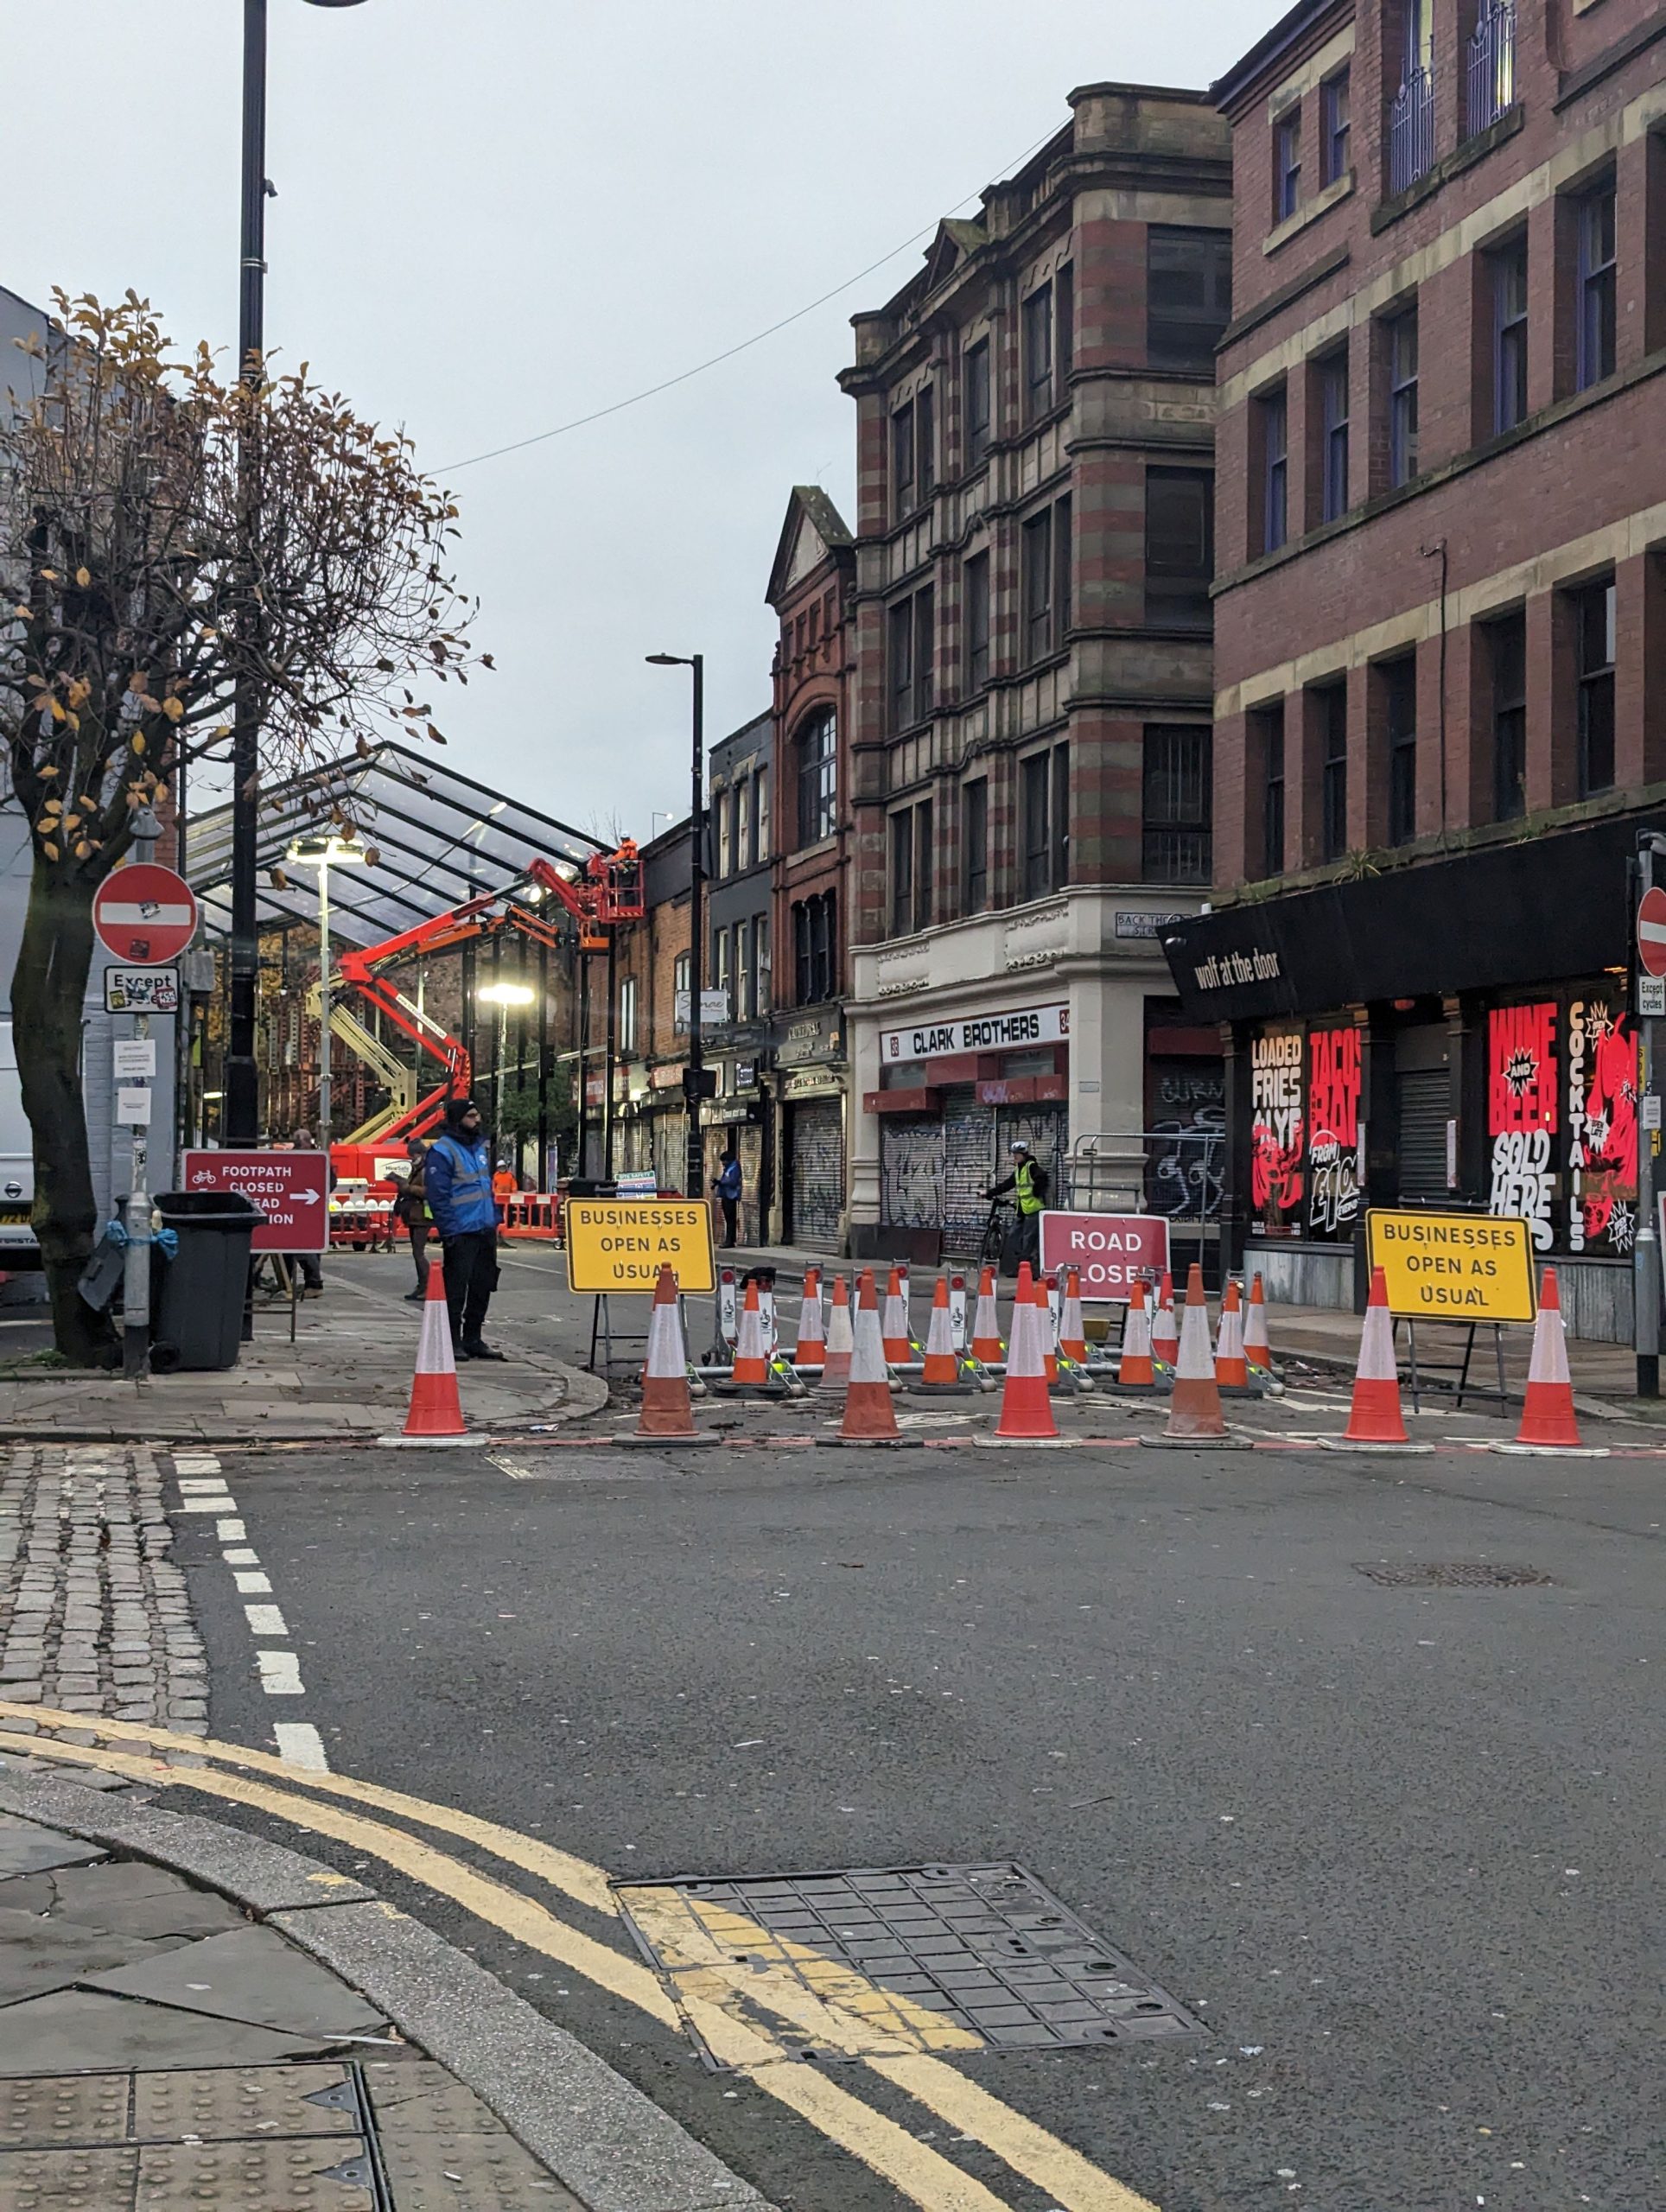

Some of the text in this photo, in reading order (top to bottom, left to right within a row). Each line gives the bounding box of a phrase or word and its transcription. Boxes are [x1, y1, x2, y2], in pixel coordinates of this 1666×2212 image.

[1118, 915, 1145, 925] BACK
[1194, 947, 1280, 989] wolf at the door
[114, 974, 172, 989] Except
[1642, 982, 1663, 994] Except
[1643, 1000, 1663, 1010] cycles
[913, 1014, 1040, 1055] CLARK BROTHERS
[1489, 1002, 1557, 1074] WINE
[1251, 1035, 1301, 1069] LOADED
[1510, 1063, 1530, 1078] AND
[1252, 1066, 1301, 1109] FRIES
[1489, 1071, 1557, 1136] BEER
[1568, 1001, 1585, 1251] COCKTAILS
[1311, 1141, 1338, 1165] FROM
[1491, 1128, 1550, 1175] SOLD
[222, 1166, 291, 1177] FOOTPATH
[230, 1182, 283, 1192] CLOSED
[1489, 1173, 1555, 1218] HERE
[581, 1210, 697, 1225] BUSINESSES
[601, 1237, 681, 1251] OPEN AS
[1071, 1230, 1141, 1251] ROAD
[1383, 1224, 1516, 1247] BUSINESSES
[613, 1264, 663, 1279] USUA
[1407, 1255, 1497, 1276] OPEN AS
[1421, 1286, 1490, 1306] USUAL
